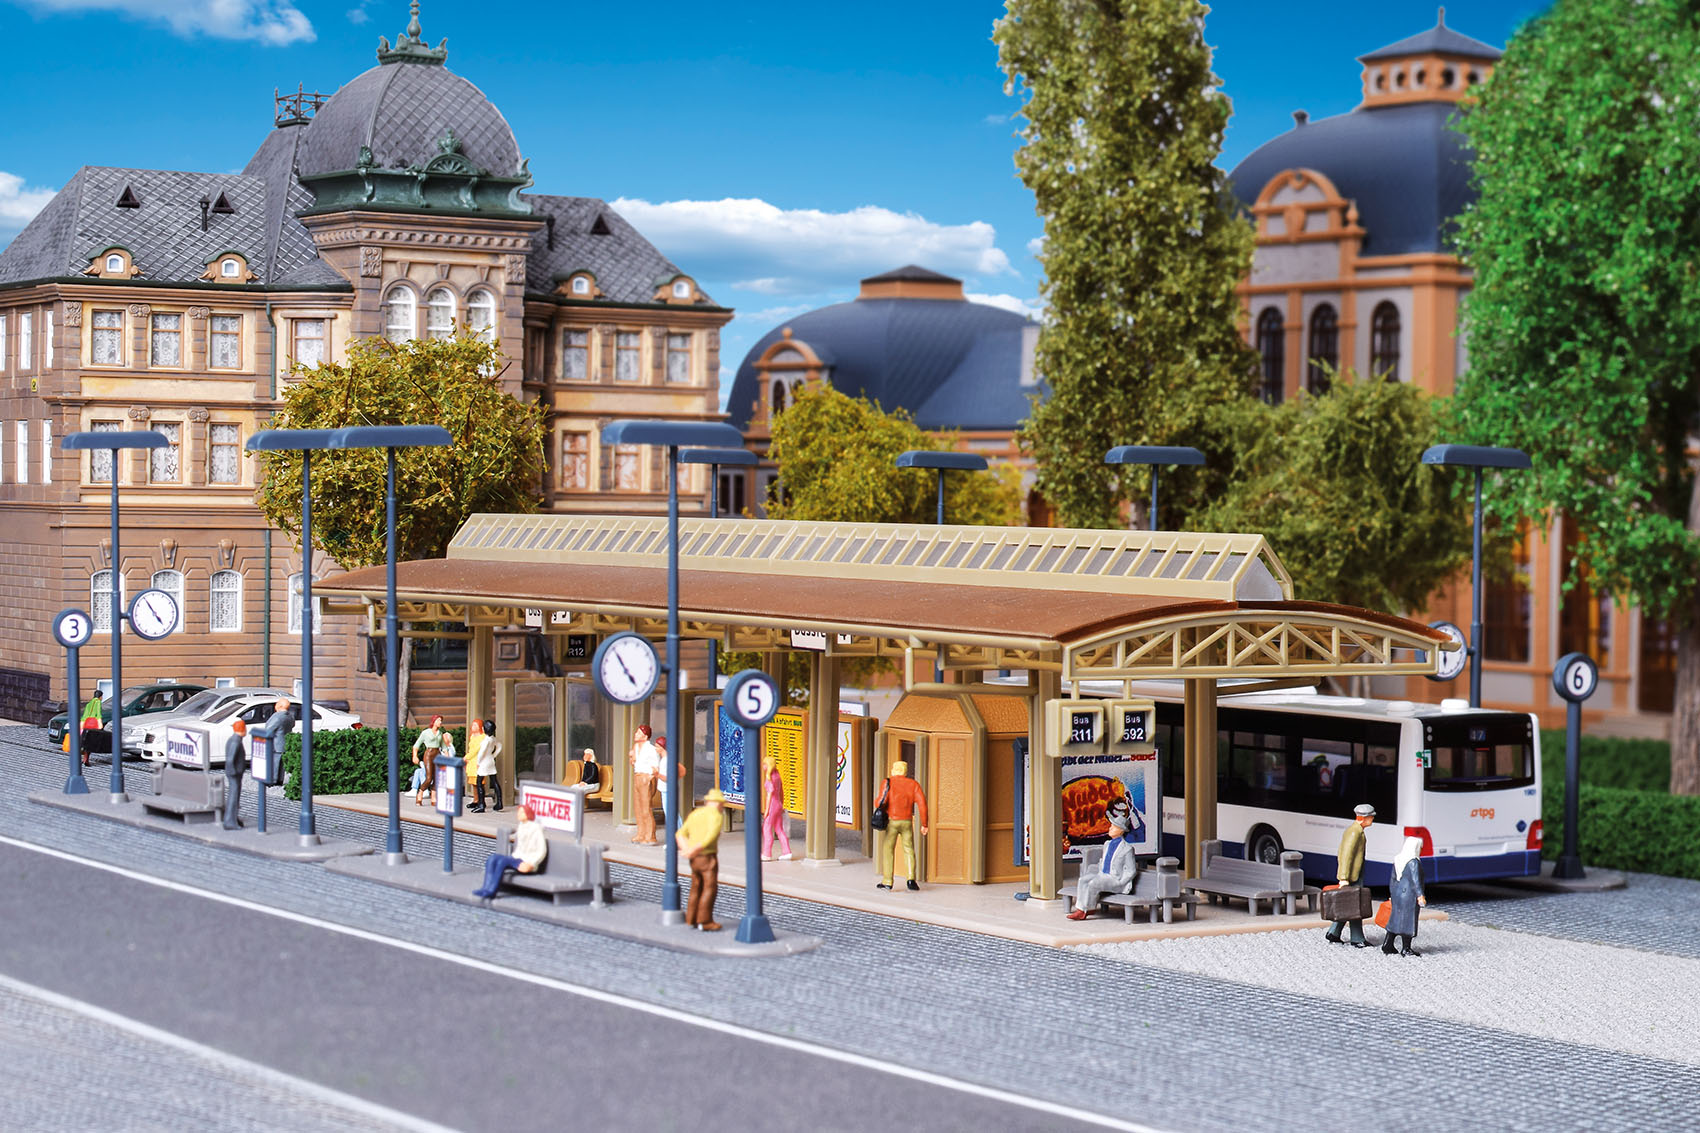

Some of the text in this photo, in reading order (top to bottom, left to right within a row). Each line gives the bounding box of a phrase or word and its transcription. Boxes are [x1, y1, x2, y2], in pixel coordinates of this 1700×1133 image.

[69, 618, 80, 639] 3
[1573, 665, 1584, 690] 6
[748, 685, 761, 714] 5
[1073, 716, 1089, 725] Bus
[1125, 715, 1141, 724] Bus
[168, 740, 194, 756] PUMA
[525, 793, 571, 822] VOLLMER
